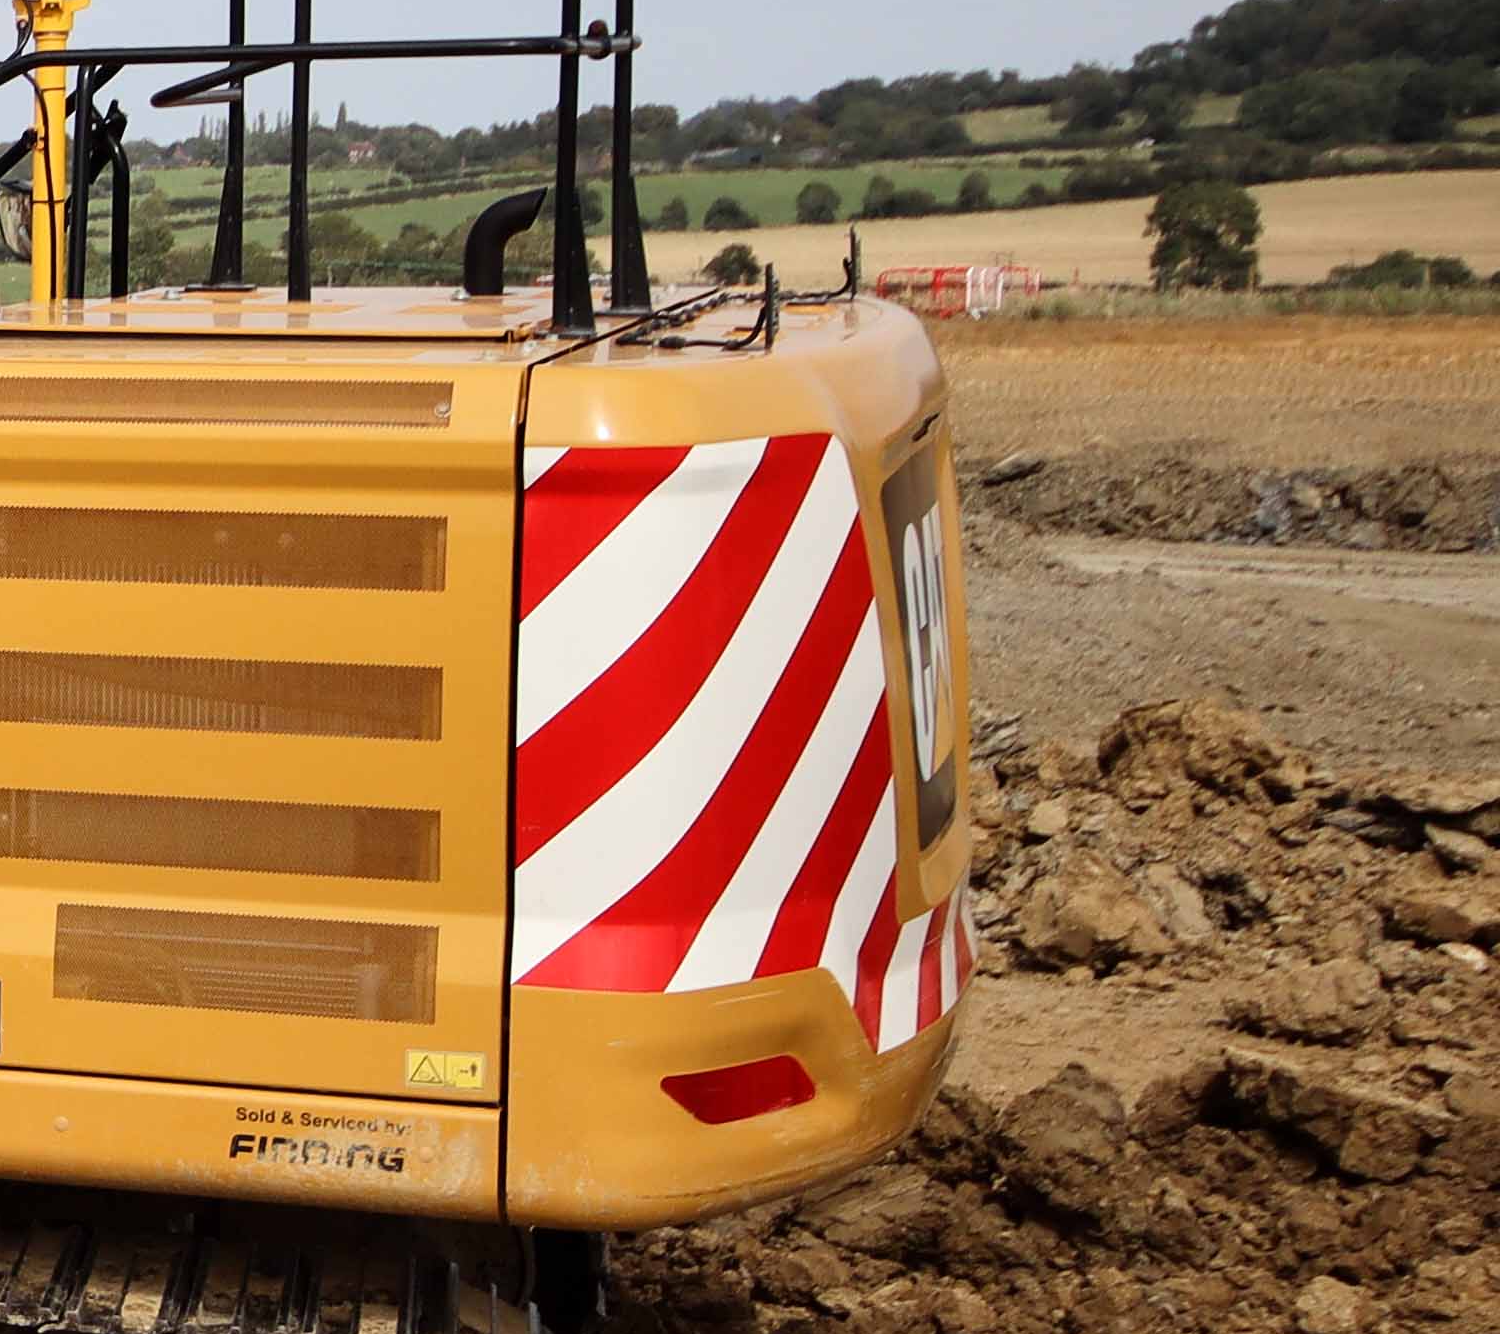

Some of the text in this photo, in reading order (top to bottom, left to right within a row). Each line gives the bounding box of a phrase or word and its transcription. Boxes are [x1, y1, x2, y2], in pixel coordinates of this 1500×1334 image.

[235, 1106, 276, 1124] Sold
[281, 1110, 294, 1125] &
[300, 1112, 378, 1133] Serviced
